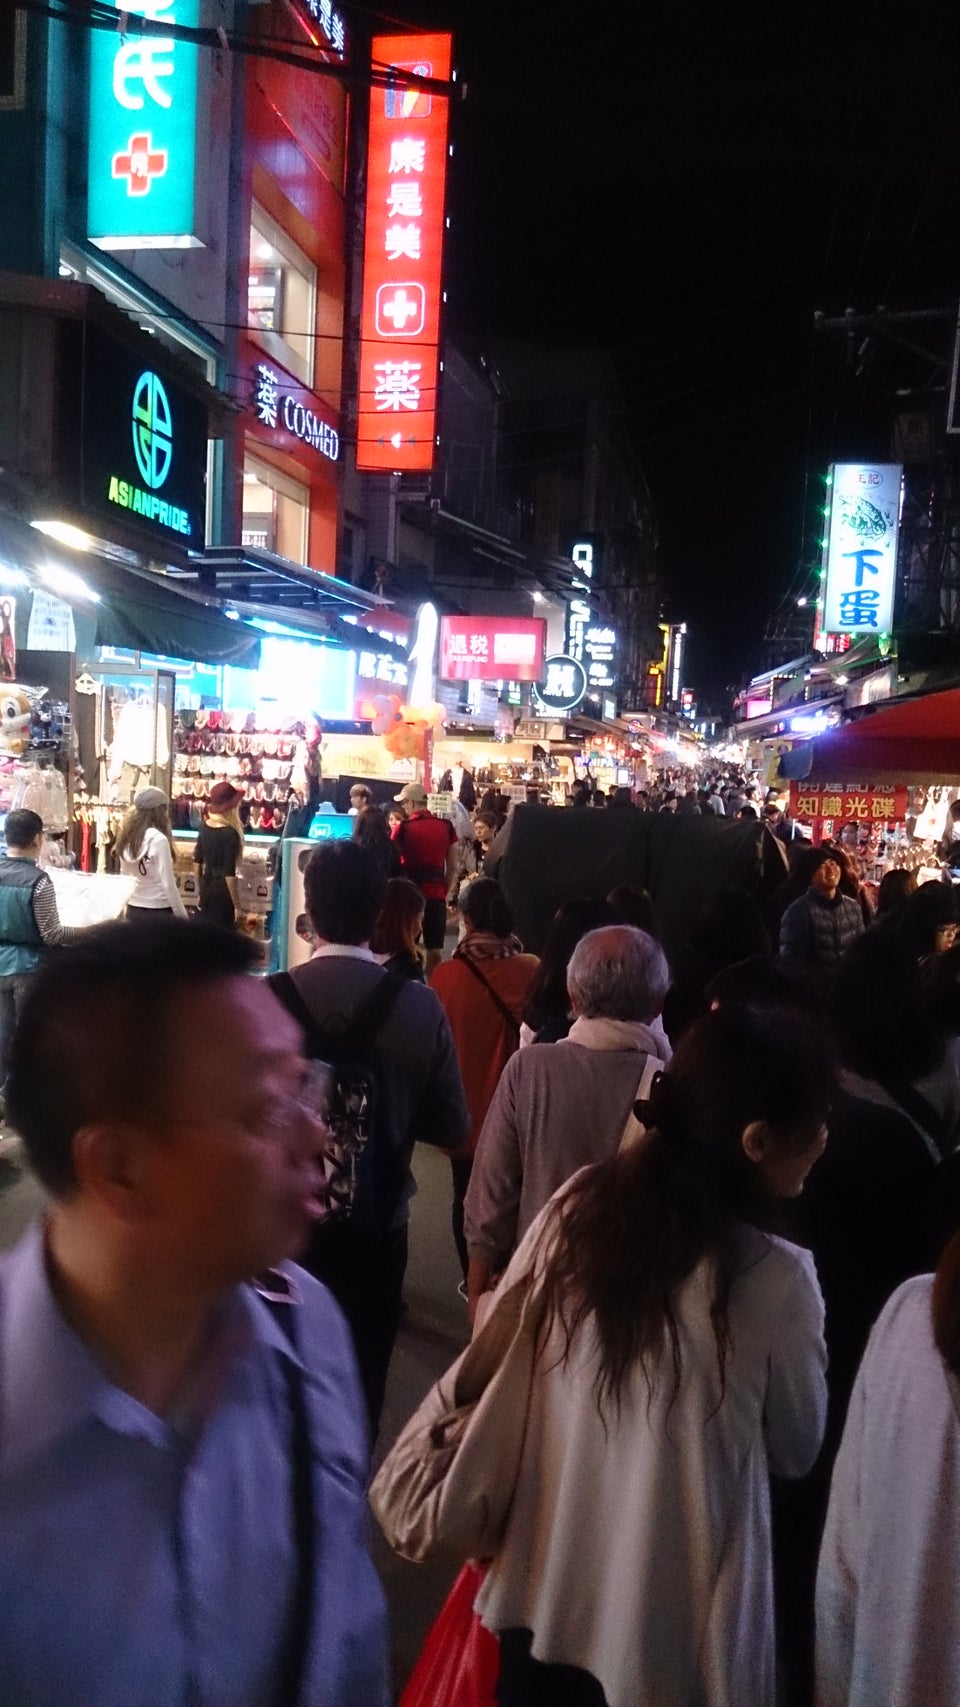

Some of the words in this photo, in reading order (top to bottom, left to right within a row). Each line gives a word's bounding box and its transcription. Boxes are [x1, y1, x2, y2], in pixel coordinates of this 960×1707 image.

[113, 0, 176, 110] 氏
[385, 138, 426, 260] 康是美
[284, 396, 339, 461] COSMED
[108, 476, 189, 535] ASIANPRIDE
[839, 549, 883, 628] 下蛋
[797, 796, 895, 818] 知識光碟
